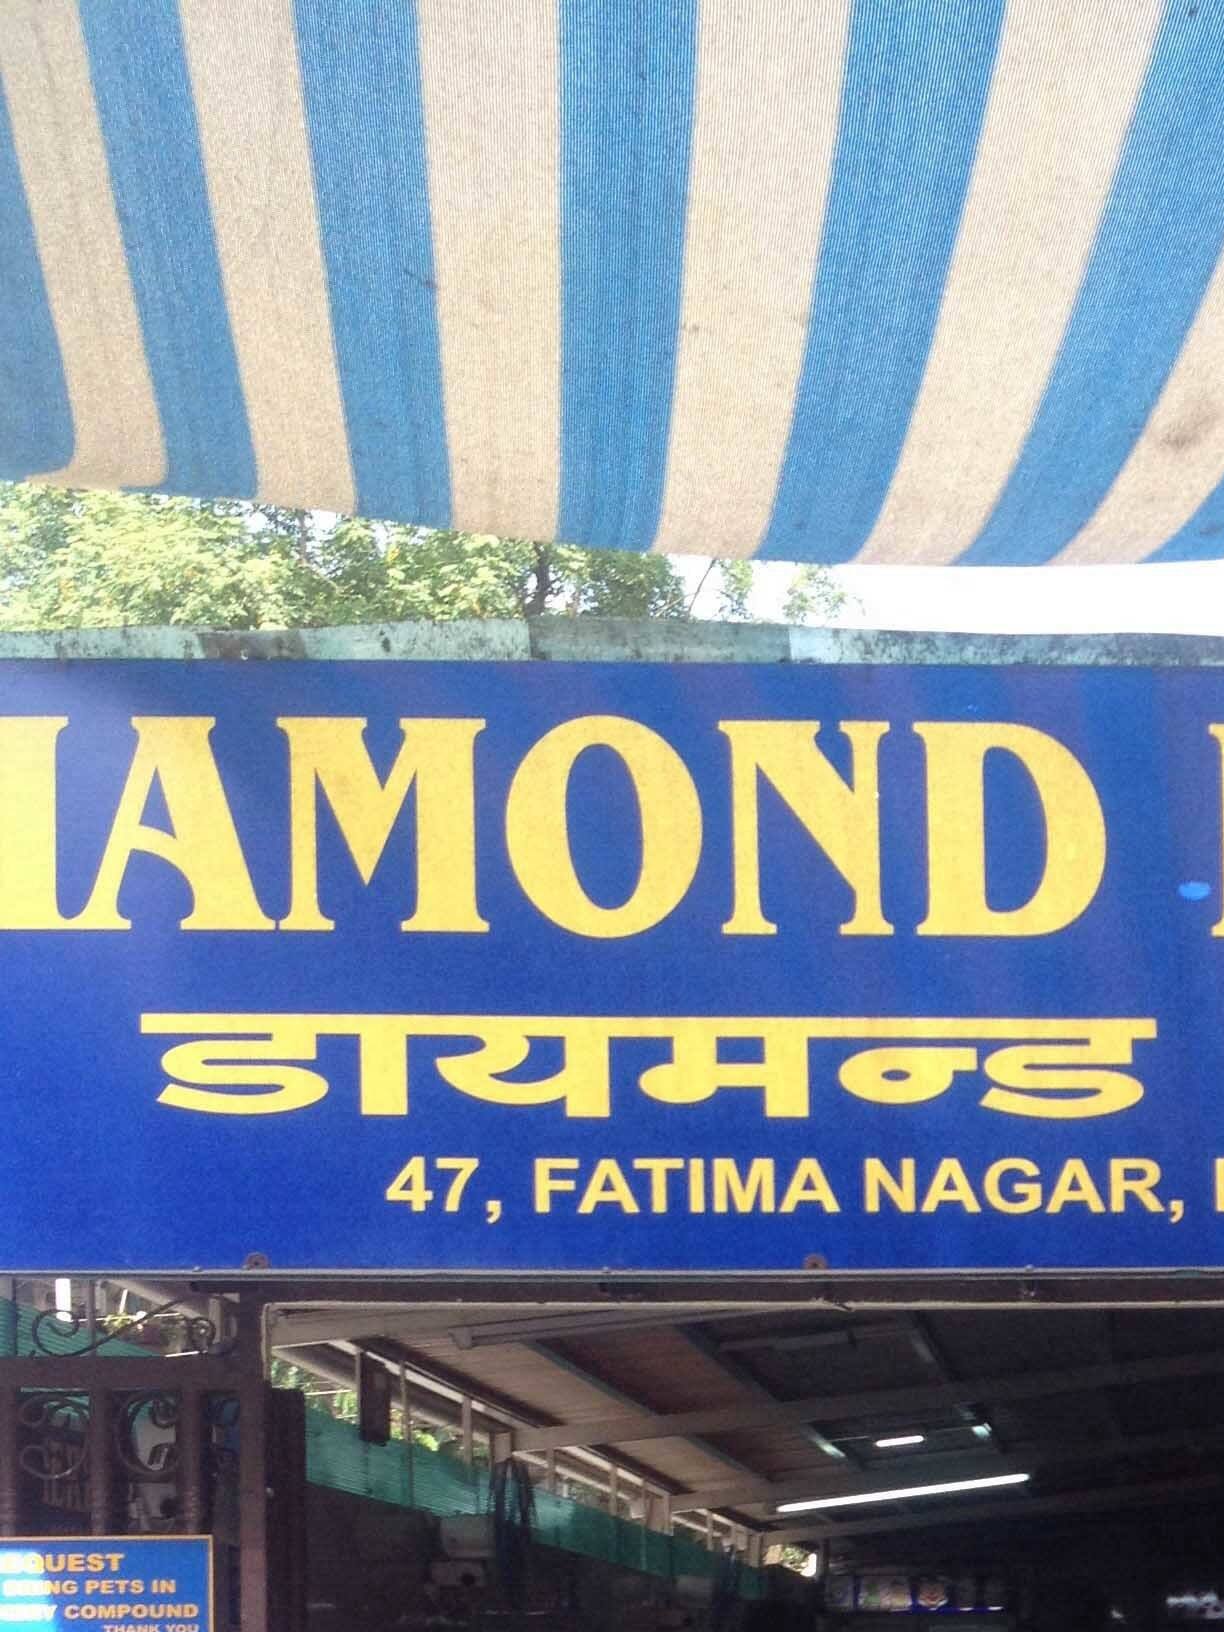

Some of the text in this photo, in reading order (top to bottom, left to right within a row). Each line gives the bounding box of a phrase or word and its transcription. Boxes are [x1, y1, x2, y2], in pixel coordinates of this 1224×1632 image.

[140, 1013, 1157, 1119] डायमन्ड
[386, 1157, 502, 1223] 47,
[534, 1158, 840, 1214] FATIMA
[864, 1158, 1185, 1223] NAGAR,
[86, 1579, 144, 1595] PETS
[152, 1579, 176, 1594] IN
[64, 1604, 199, 1619] COMPOUND
